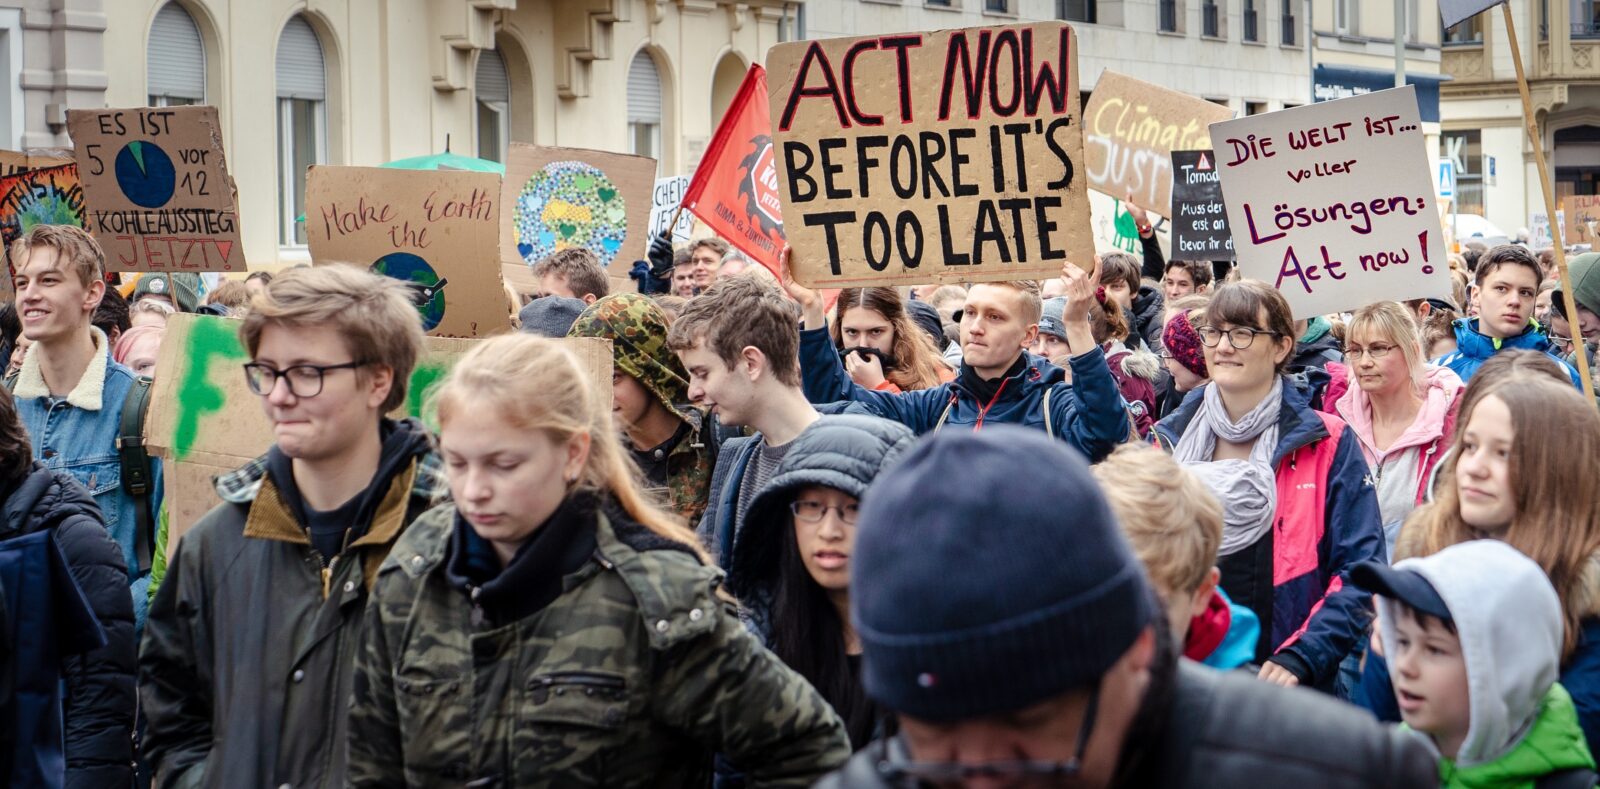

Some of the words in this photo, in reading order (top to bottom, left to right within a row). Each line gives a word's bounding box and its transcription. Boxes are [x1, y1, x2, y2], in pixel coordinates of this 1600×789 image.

[779, 34, 922, 132] ACT
[937, 27, 1070, 121] NOW
[98, 112, 126, 136] ES
[140, 112, 175, 136] IST
[1288, 122, 1352, 150] WELT
[86, 144, 105, 176] 5
[178, 149, 211, 166] vor
[783, 128, 979, 203] BEFORE
[990, 115, 1075, 193] IT'S
[1446, 136, 1465, 174] K
[0, 173, 47, 215] THIS
[180, 170, 210, 196] 12
[96, 207, 234, 235] KOHLEAUSSTIEG
[320, 197, 398, 241] Make
[423, 188, 492, 224] Earth
[1181, 203, 1206, 216] Muss
[1207, 200, 1223, 214] der
[1192, 217, 1209, 231] erst
[1213, 219, 1225, 231] an
[1243, 196, 1426, 245] Lösungen:
[387, 220, 432, 249] the
[715, 201, 736, 225] KLIMA
[745, 225, 777, 256] ZUKUNFT
[803, 210, 924, 276] TOO
[937, 197, 1067, 266] LATE
[1179, 234, 1206, 251] bevor
[1209, 235, 1220, 250] ihr
[116, 235, 233, 270] JETZT!
[1275, 245, 1347, 293] Act
